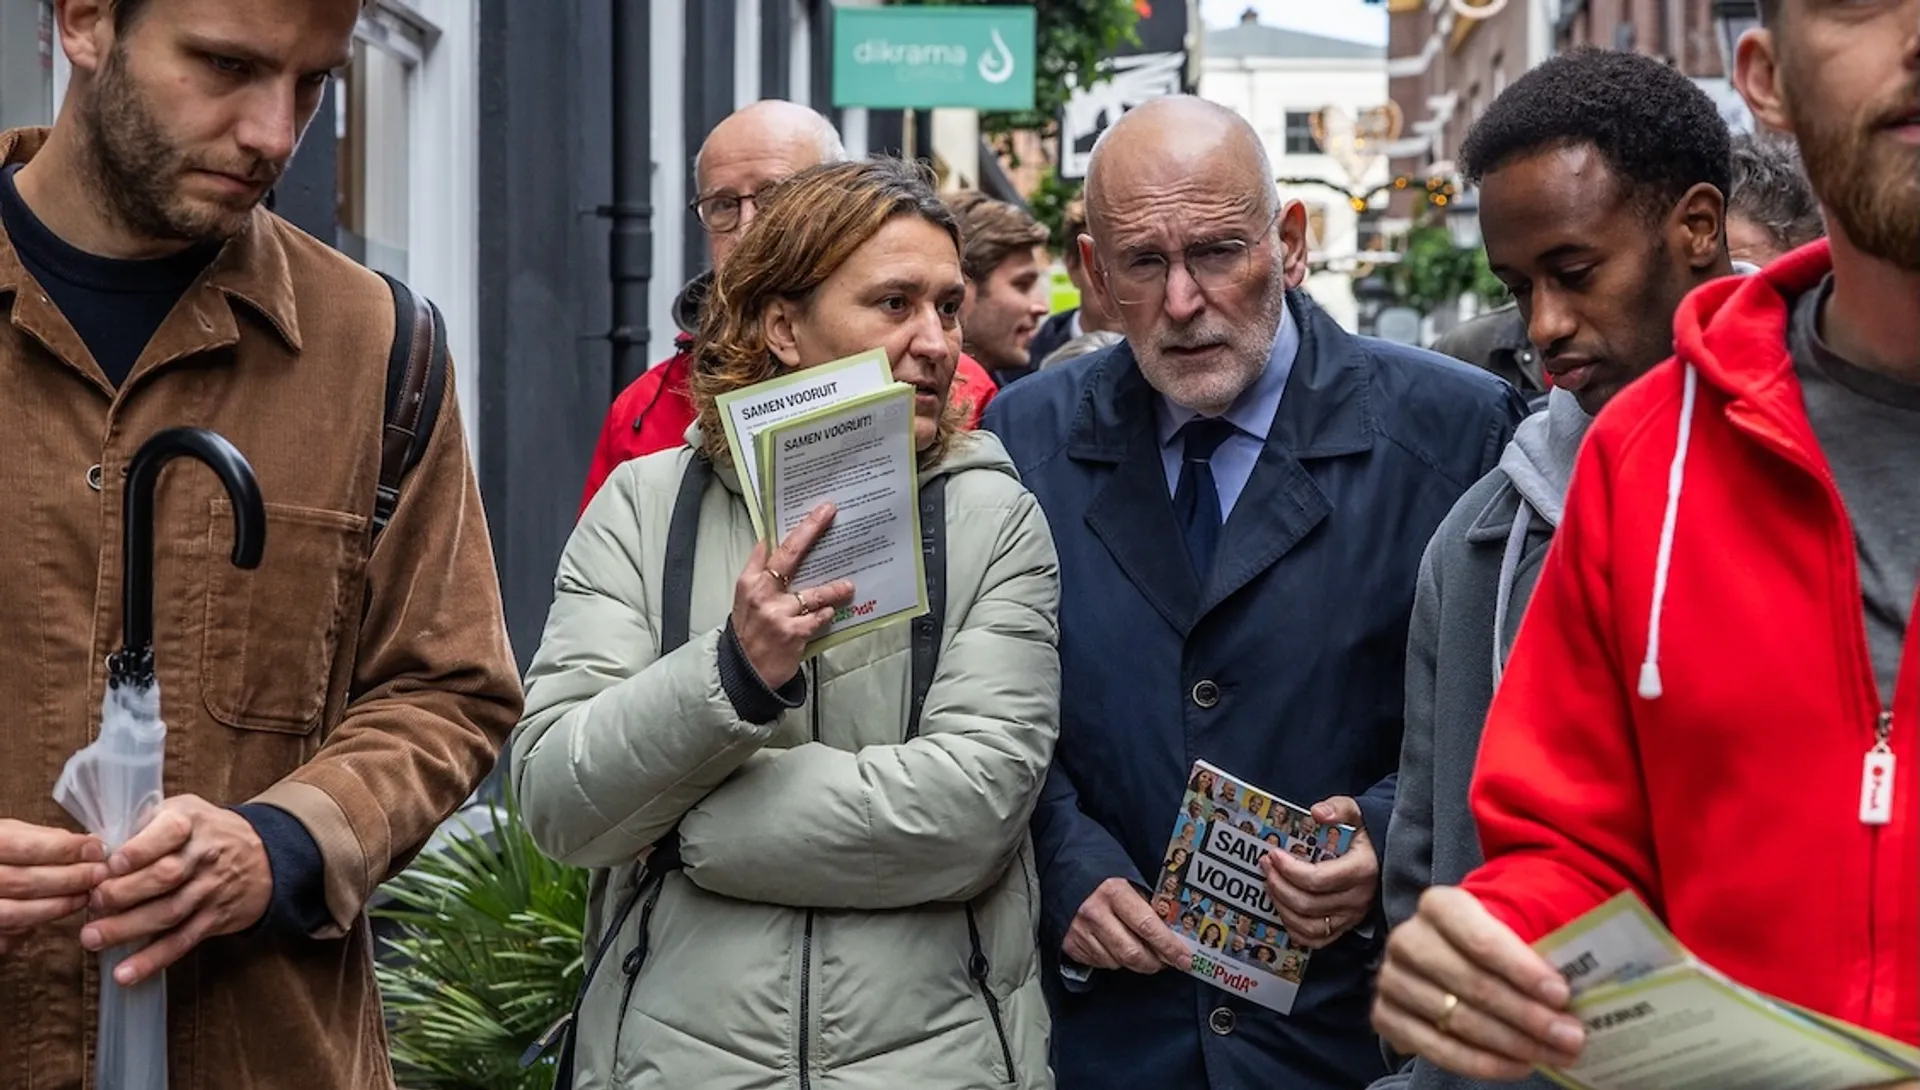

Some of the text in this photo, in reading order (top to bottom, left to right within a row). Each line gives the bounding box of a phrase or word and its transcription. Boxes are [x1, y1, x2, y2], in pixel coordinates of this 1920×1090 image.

[741, 398, 786, 421] SAMEN
[786, 381, 838, 407] VOORUIT
[783, 430, 823, 452] SAMEN
[1214, 829, 1270, 867] SAM
[1197, 860, 1278, 915] VOORU
[1212, 963, 1249, 994] PvdA
